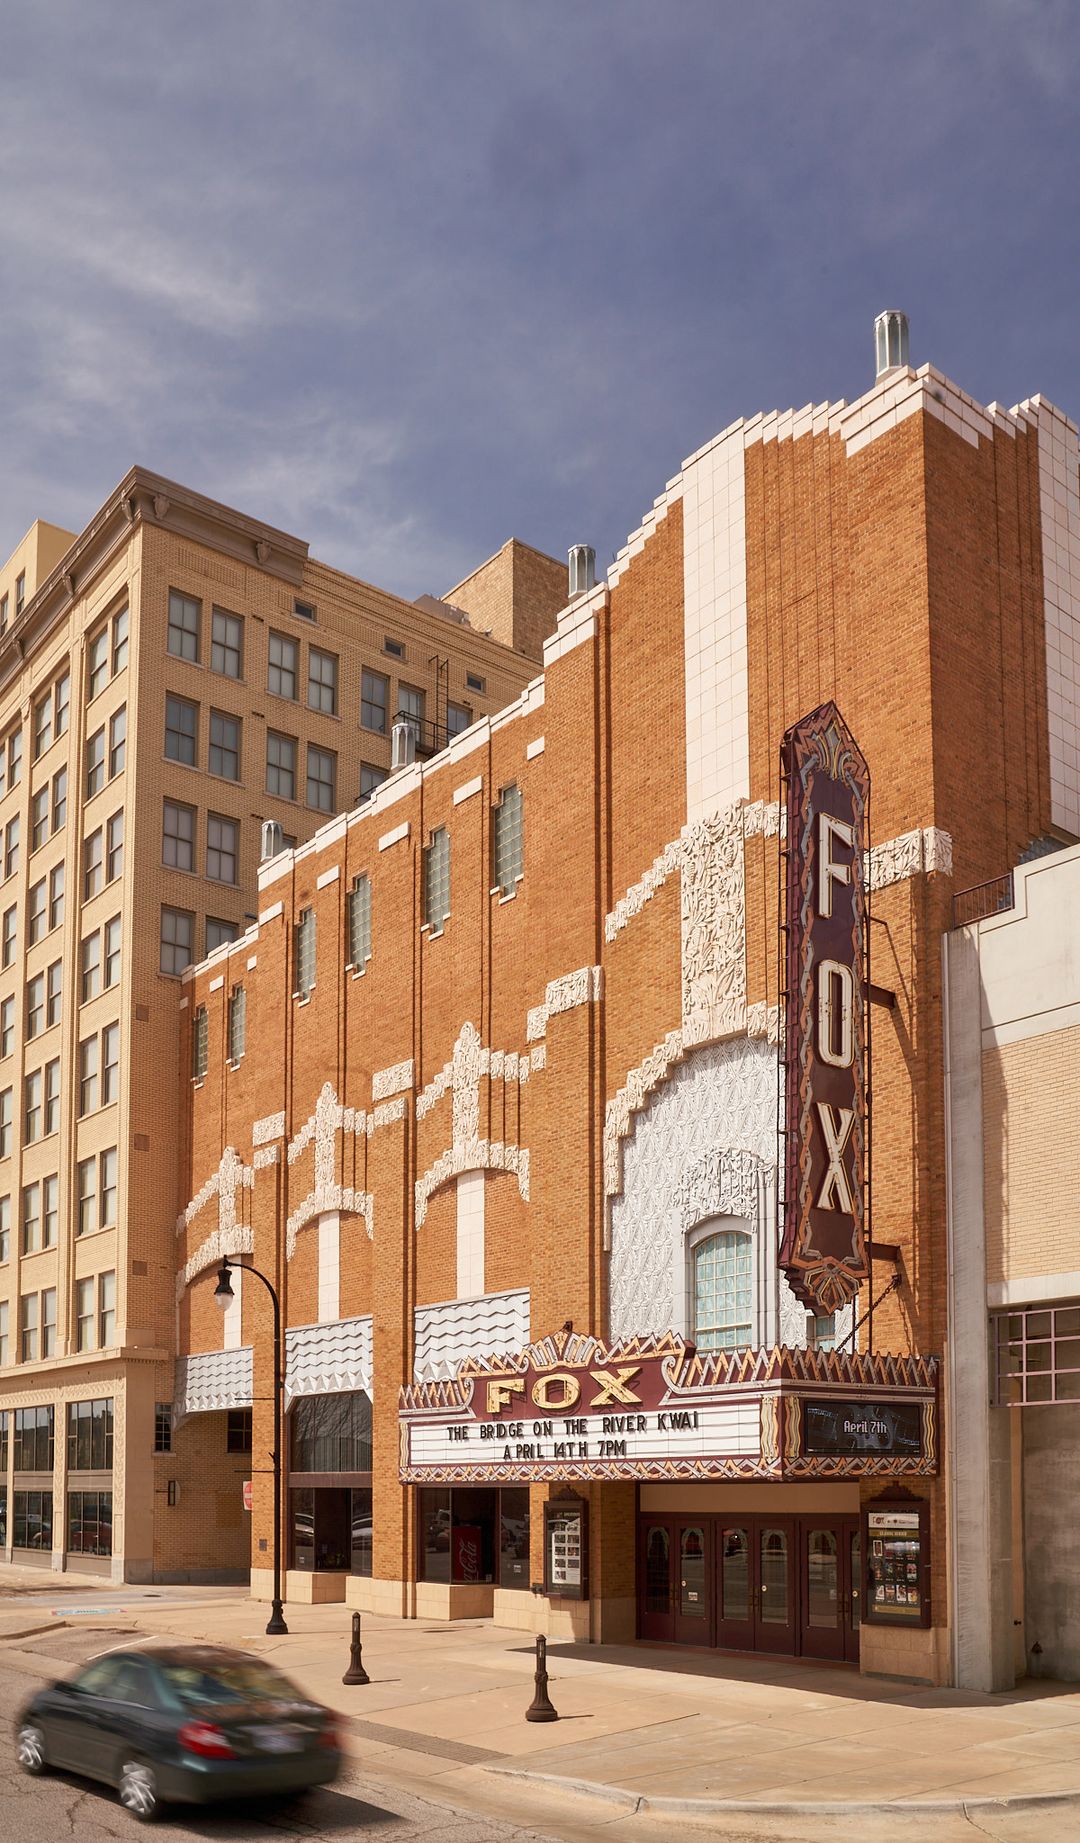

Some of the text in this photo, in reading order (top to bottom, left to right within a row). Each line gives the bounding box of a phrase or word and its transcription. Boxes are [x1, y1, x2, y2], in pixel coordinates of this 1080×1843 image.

[815, 812, 856, 1214] FOX
[486, 1366, 643, 1413] FOX
[446, 1410, 699, 1441] THE BRIDGE ON THE RIVER KWAI
[843, 1420, 887, 1434] April 7th
[503, 1439, 627, 1460] APRIL 14TH 7PM
